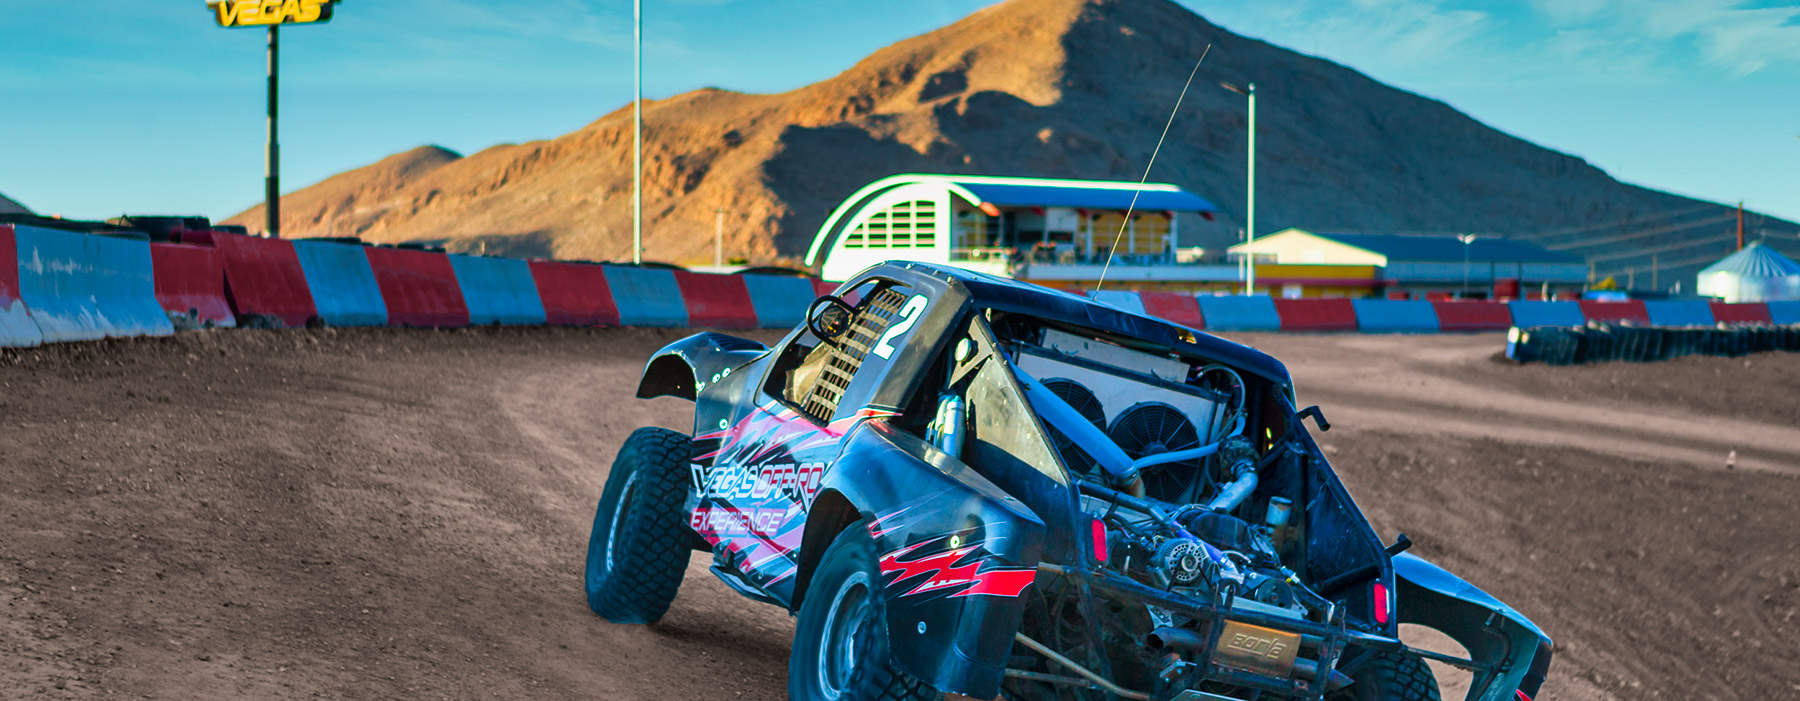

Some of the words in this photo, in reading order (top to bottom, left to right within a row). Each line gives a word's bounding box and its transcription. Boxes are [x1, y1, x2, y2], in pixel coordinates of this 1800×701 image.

[219, 0, 328, 26] VEGAS
[872, 294, 928, 360] 2
[690, 463, 758, 499] VEGAS
[752, 462, 832, 514] OFF-RO
[691, 509, 785, 533] EXPERIENCE
